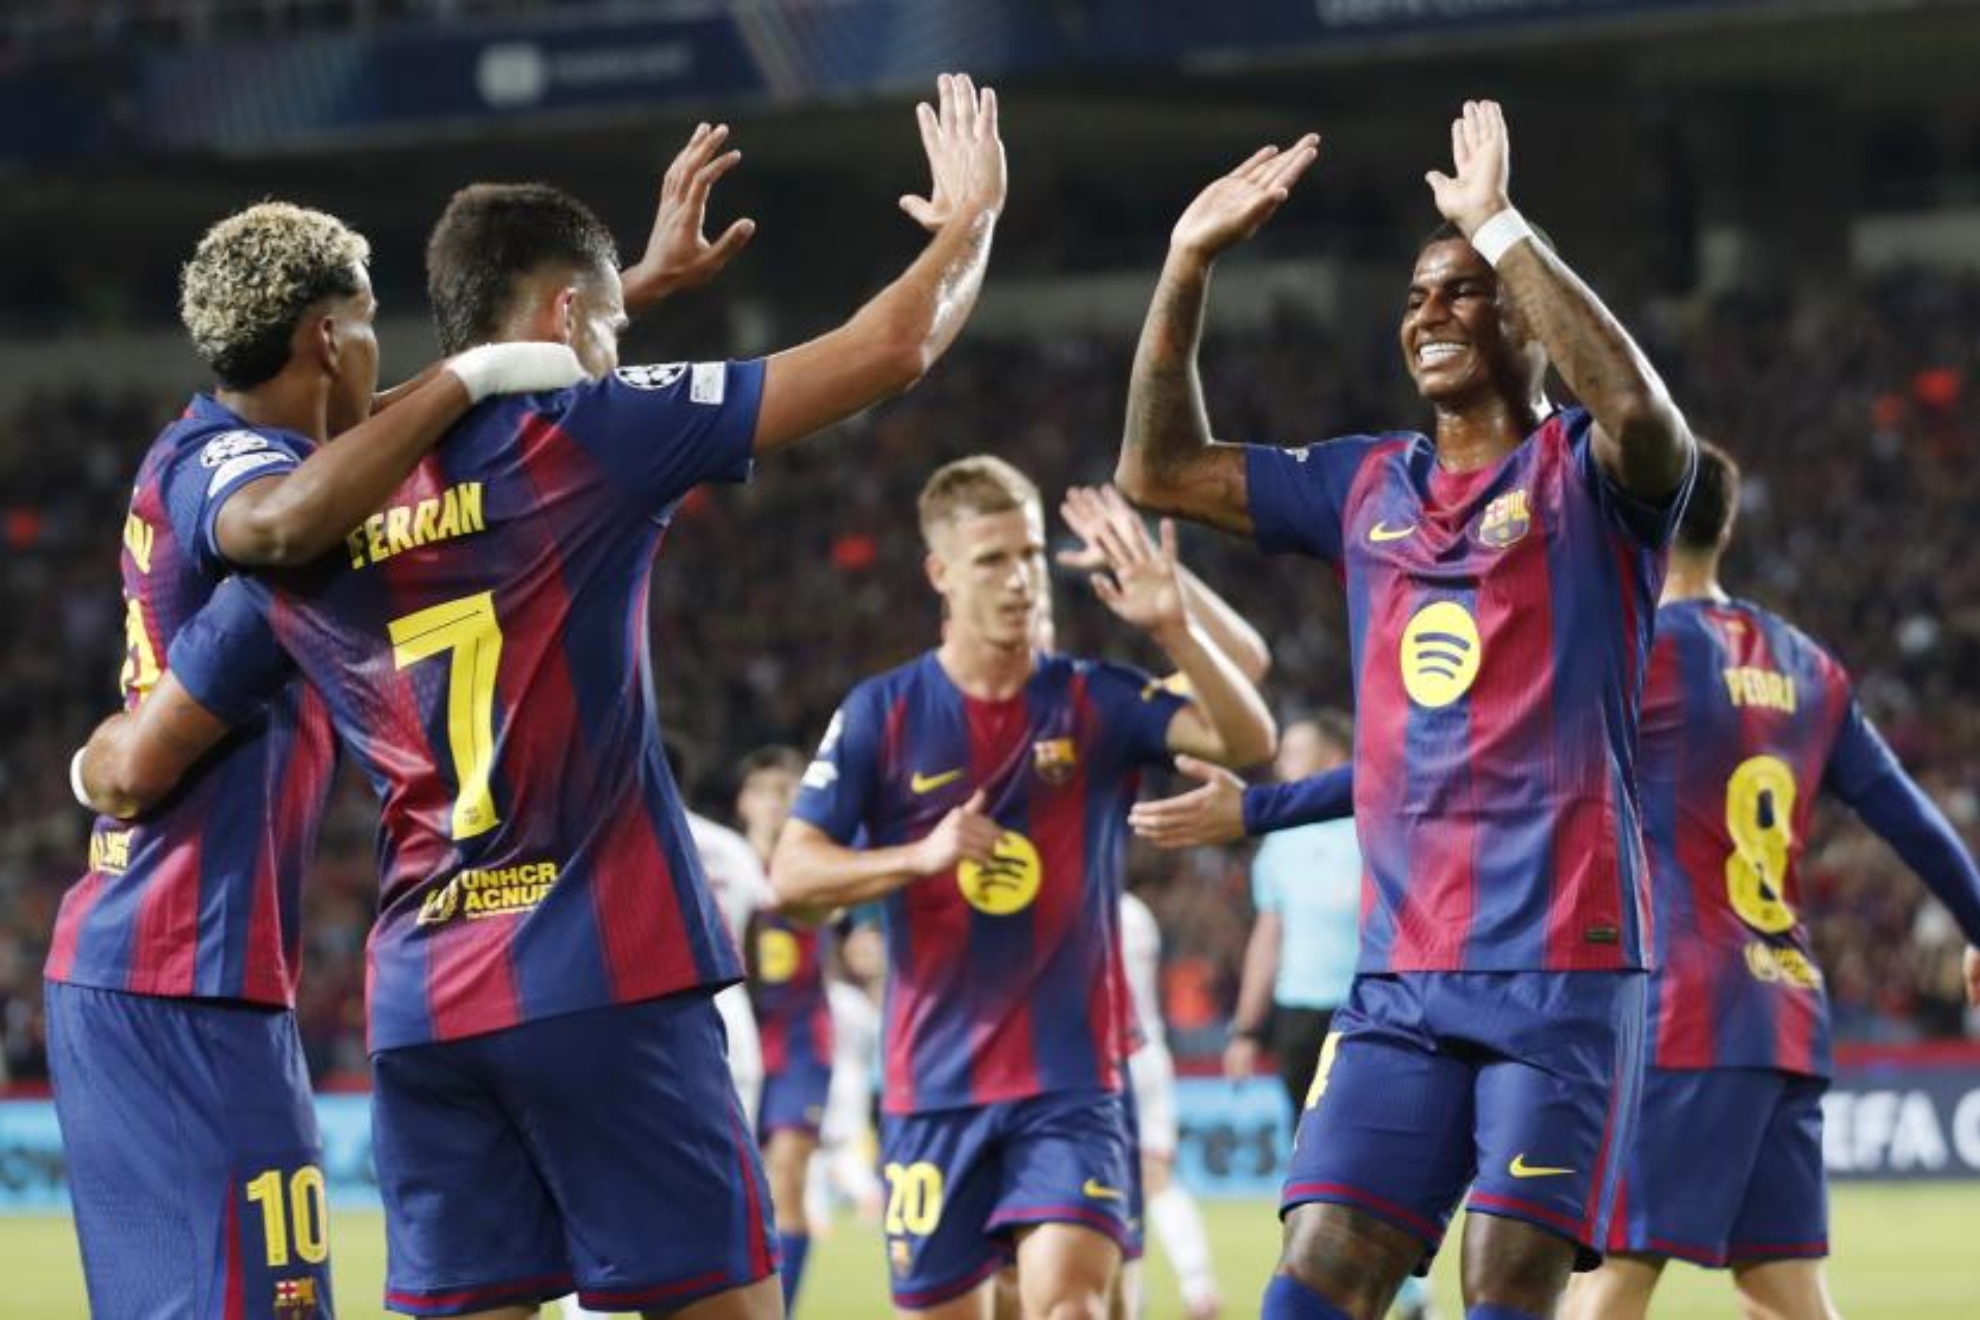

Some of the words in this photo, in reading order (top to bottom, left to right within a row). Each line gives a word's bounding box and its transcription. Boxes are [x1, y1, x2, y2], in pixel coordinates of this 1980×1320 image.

[350, 482, 486, 569] FERRAN
[388, 589, 502, 840] 7
[1724, 665, 1796, 713] PEDRI
[461, 863, 558, 890] UNHCR
[1726, 755, 1796, 933] 8
[246, 1165, 328, 1266] 10
[884, 1161, 942, 1235] 20
